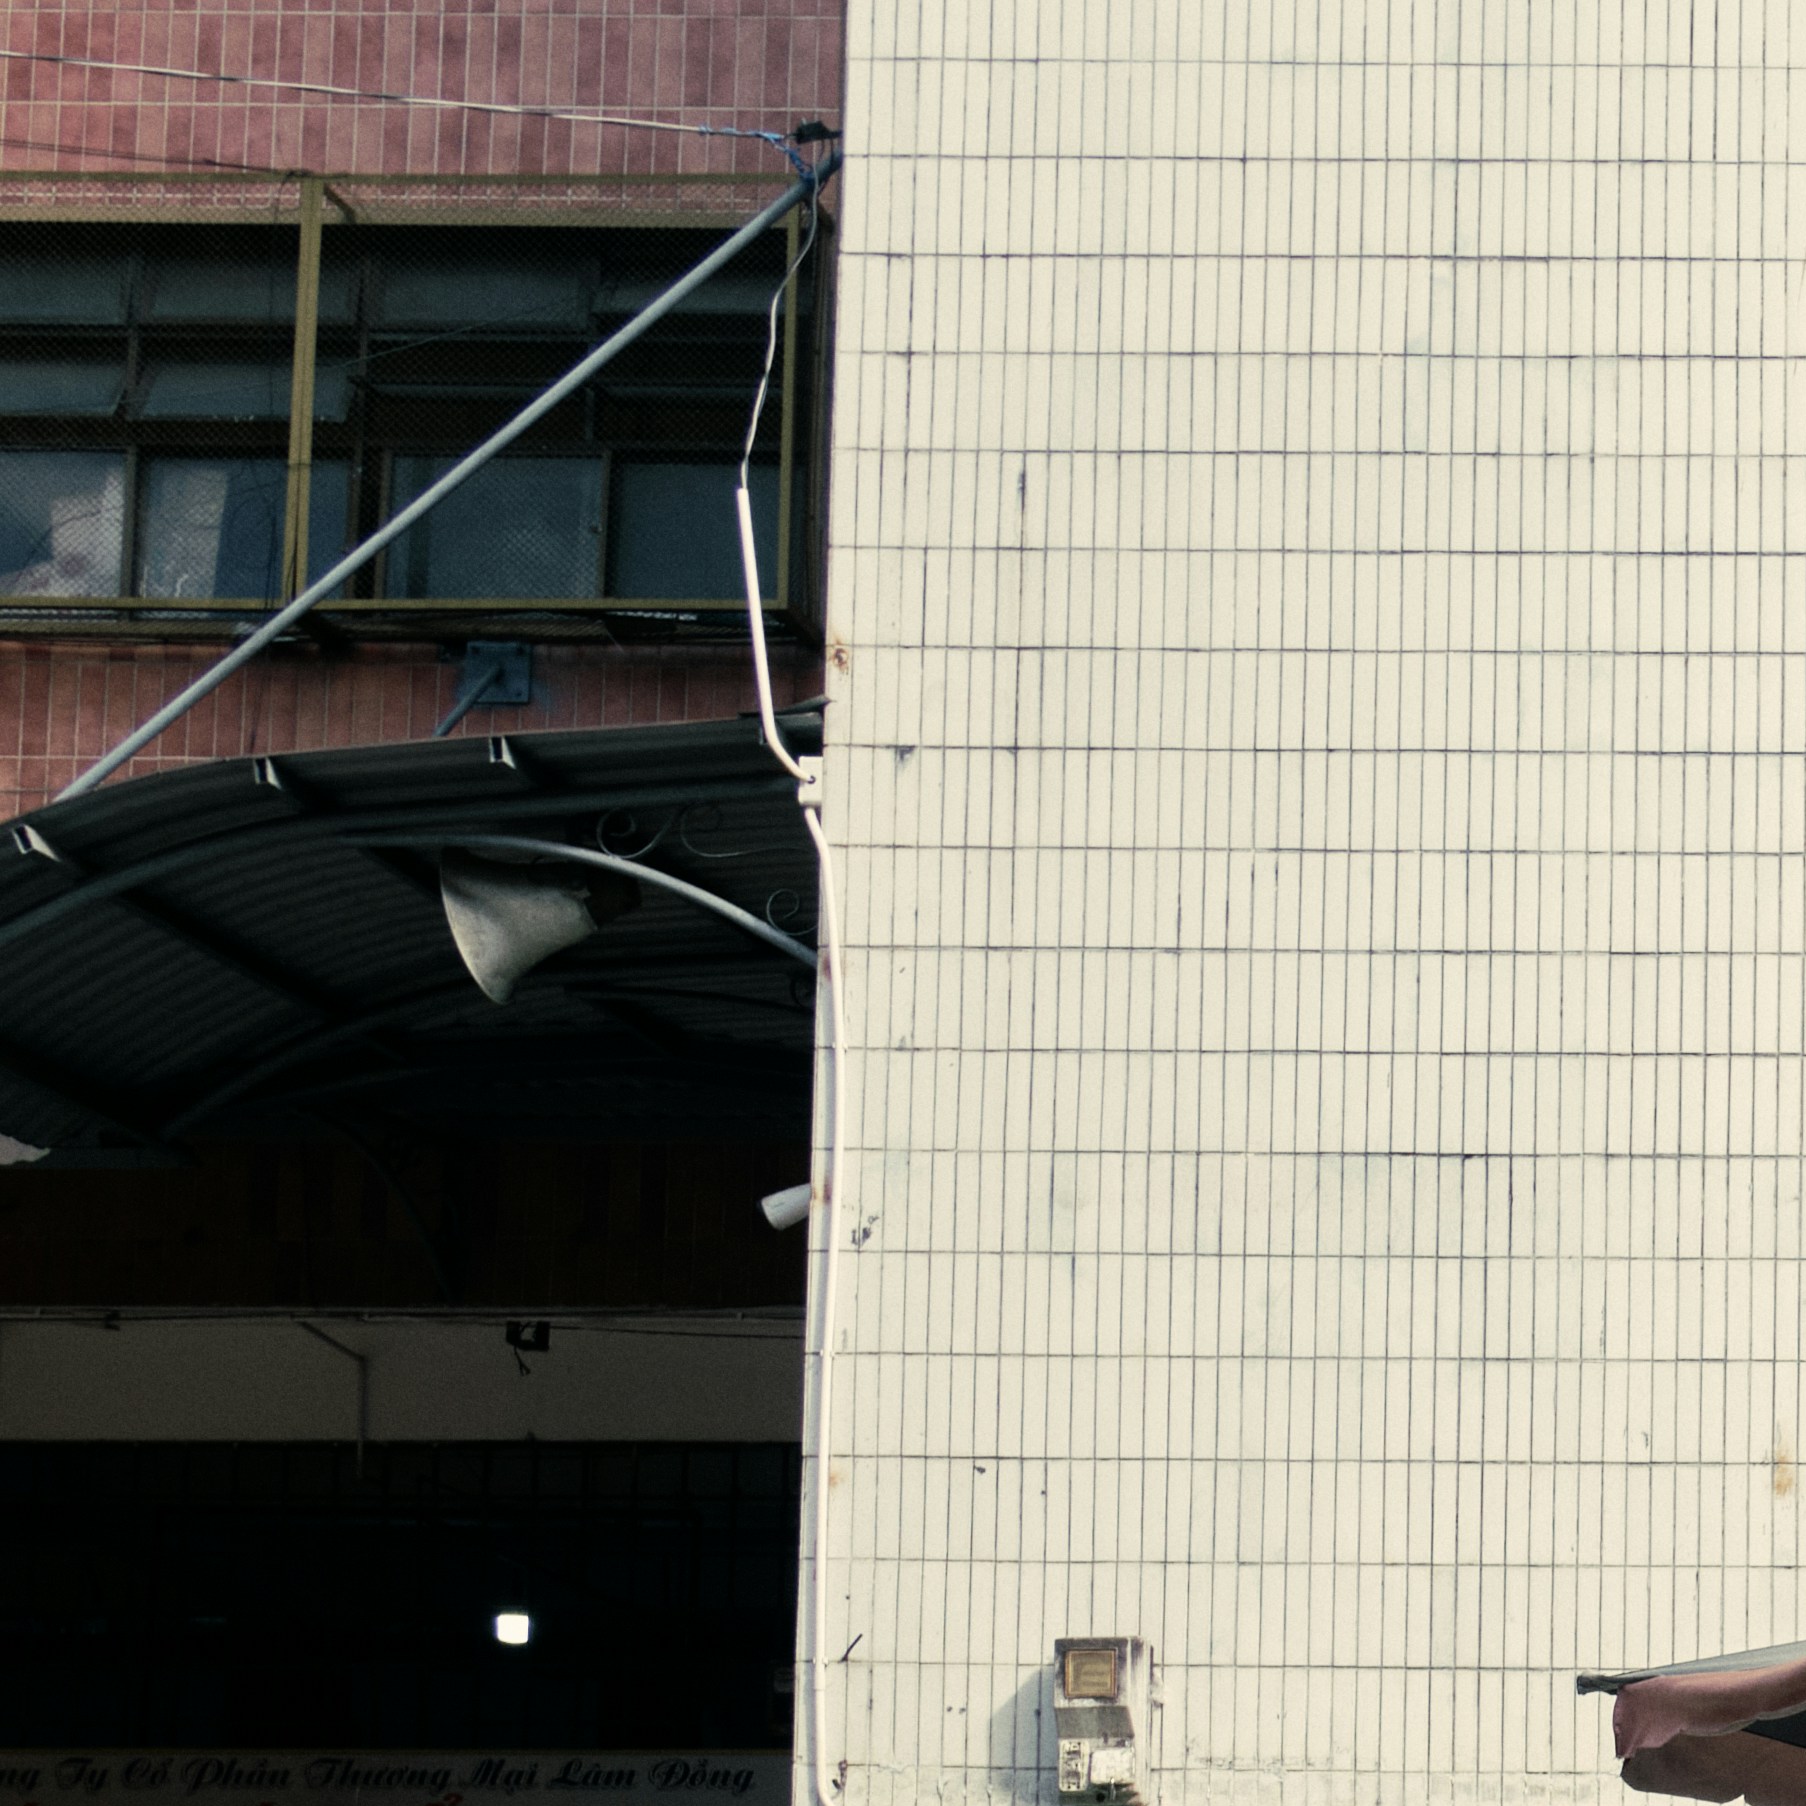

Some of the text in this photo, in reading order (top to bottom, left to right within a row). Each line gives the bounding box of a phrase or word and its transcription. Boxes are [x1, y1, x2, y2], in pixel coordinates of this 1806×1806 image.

[55, 1757, 108, 1793] Ty
[546, 1757, 636, 1791] Lâm
[647, 1757, 755, 1794] Đồng
